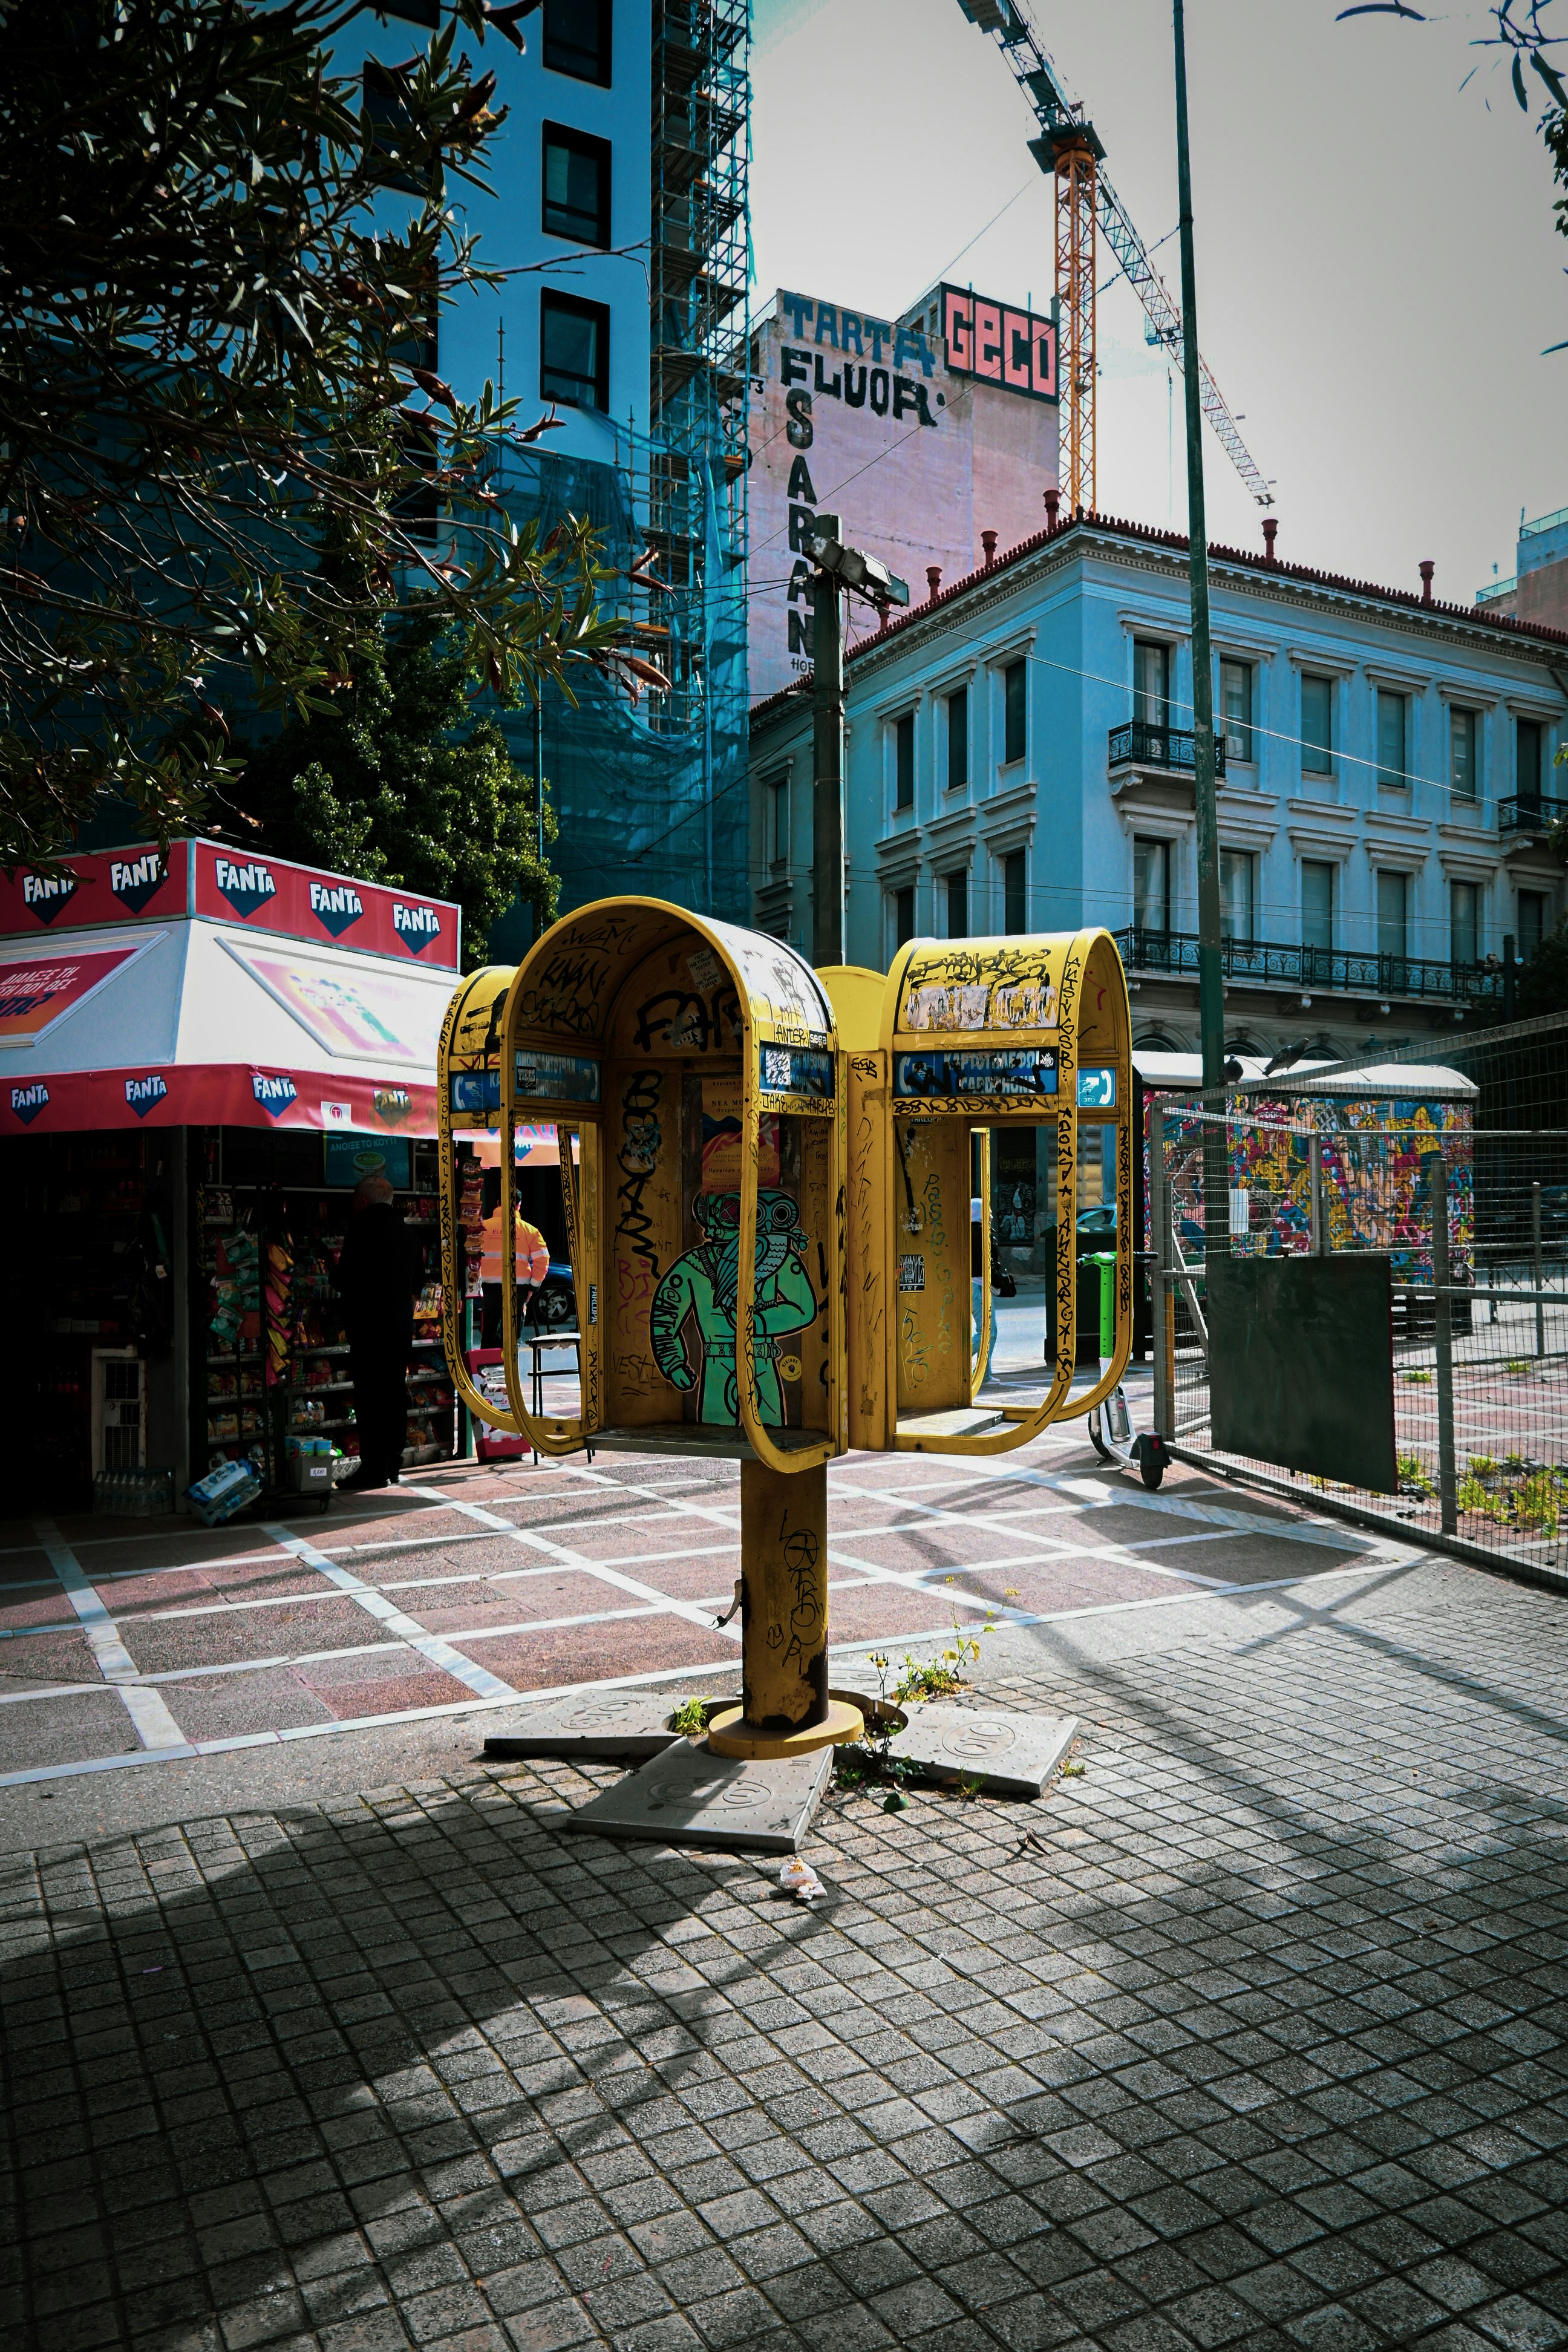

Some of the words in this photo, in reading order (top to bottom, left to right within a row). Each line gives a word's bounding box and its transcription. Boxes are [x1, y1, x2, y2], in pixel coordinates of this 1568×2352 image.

[216, 858, 275, 893] FANTA
[310, 883, 363, 914] FANTA
[393, 904, 440, 932] FANTA
[809, 1033, 828, 1045] sega
[11, 1084, 49, 1108] FANTA
[126, 1076, 166, 1100] FANTA
[253, 1077, 297, 1099] FANTA
[330, 1140, 360, 1152] ΑΝΟΙΞΕ
[363, 1139, 373, 1148] ΤΟ
[373, 1137, 397, 1148] ΚΟΥΤΙ
